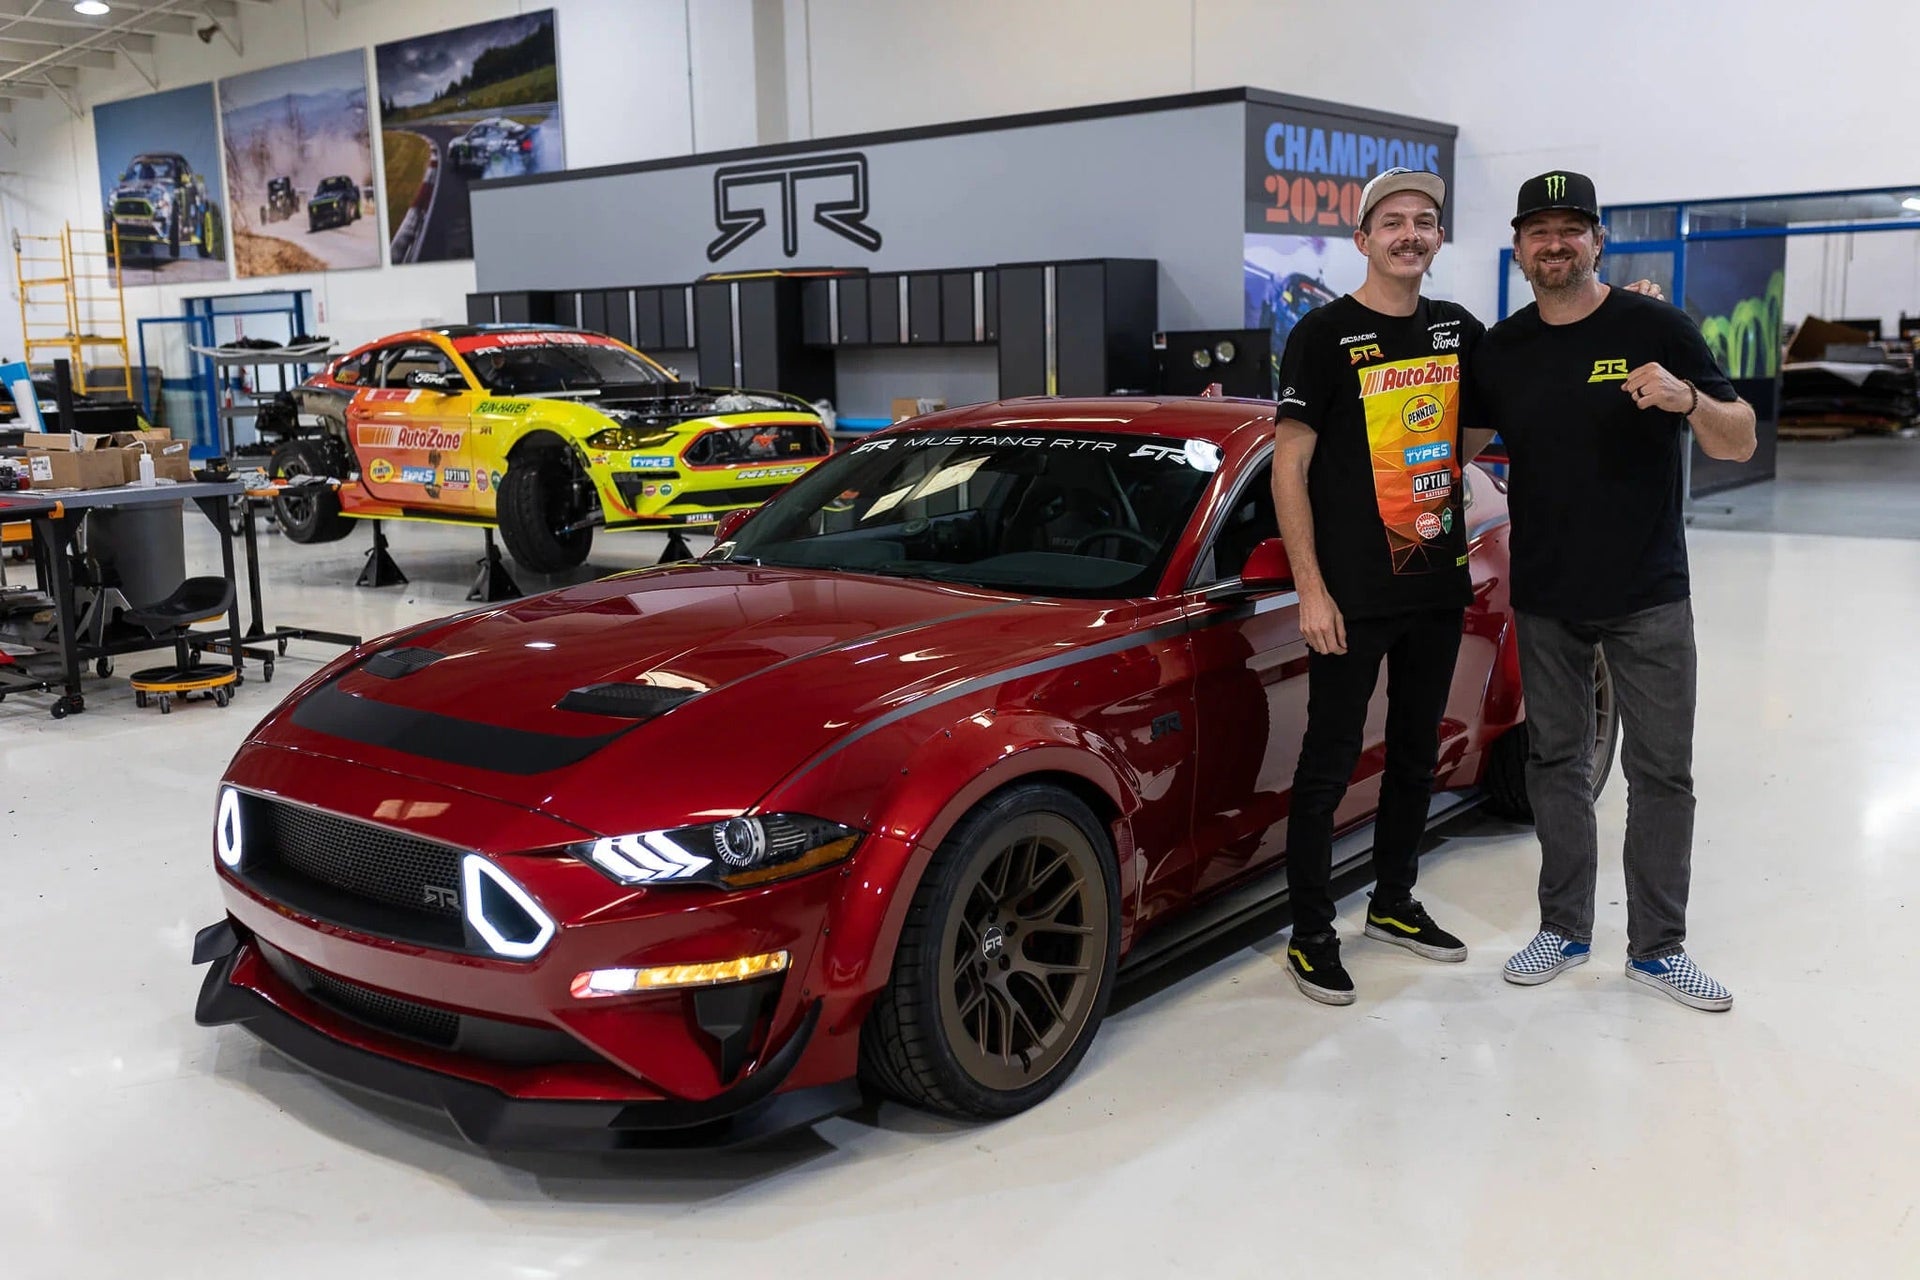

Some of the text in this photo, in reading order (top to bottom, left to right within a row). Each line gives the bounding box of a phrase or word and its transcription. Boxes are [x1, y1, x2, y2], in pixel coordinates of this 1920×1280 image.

[1264, 122, 1440, 178] CHAMPIONS
[706, 151, 882, 263] RTR
[1432, 331, 1460, 350] Ford
[414, 373, 446, 385] Ford
[1381, 361, 1460, 392] AutoZone
[1408, 403, 1438, 425] PENNZOIL
[398, 426, 461, 450] AutoZone
[904, 436, 1117, 453] MUSTANG RTR
[737, 466, 805, 480] NITTO
